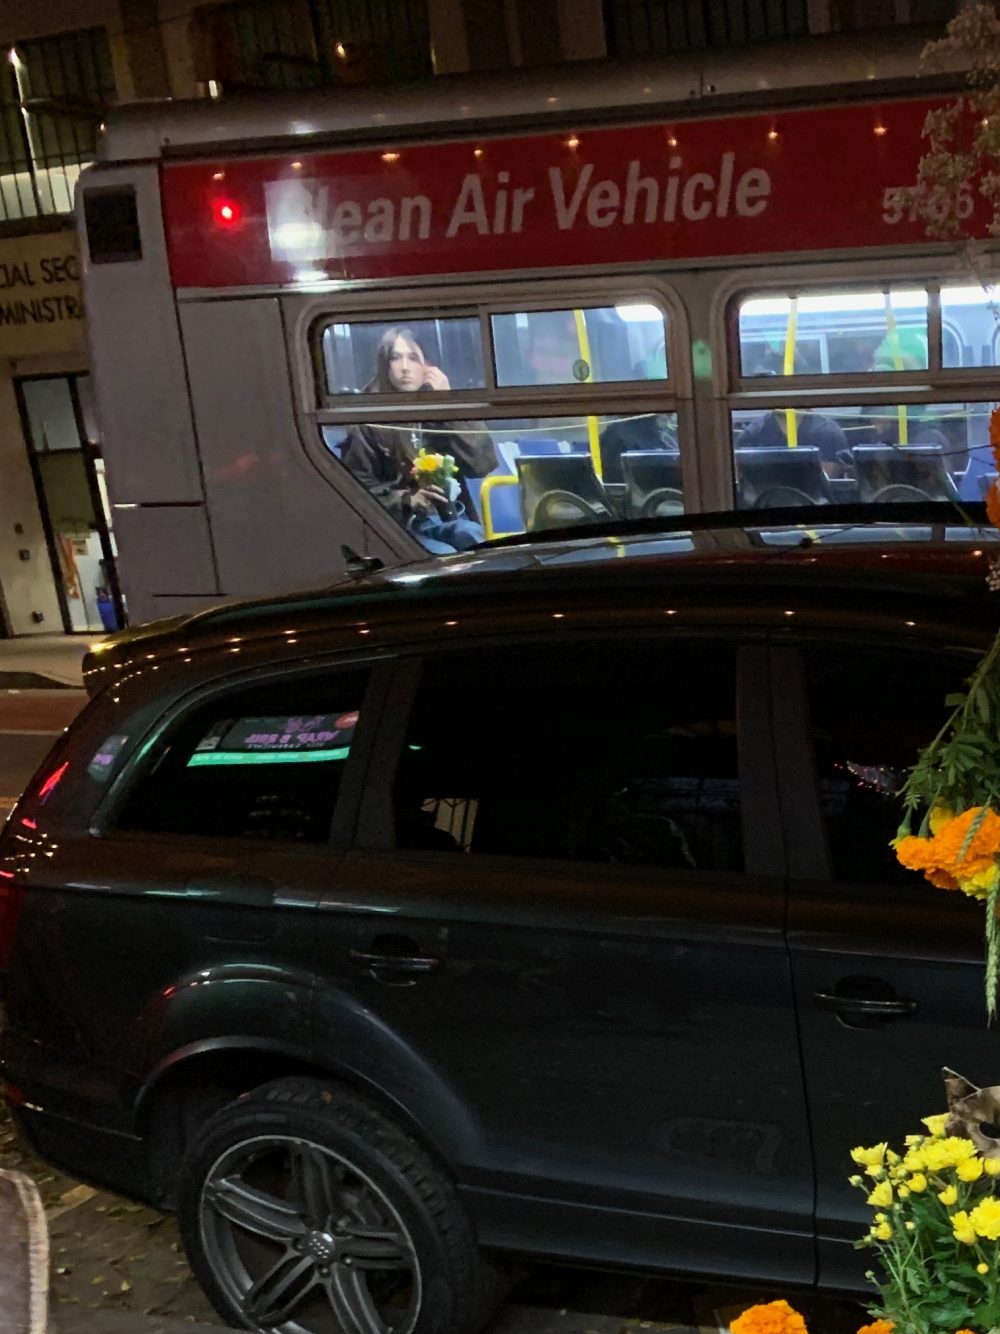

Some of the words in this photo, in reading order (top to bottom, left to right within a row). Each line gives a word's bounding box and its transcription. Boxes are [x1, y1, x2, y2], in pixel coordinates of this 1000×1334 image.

[294, 184, 431, 246] lean
[445, 170, 535, 238] Air
[549, 151, 773, 231] Vehicle
